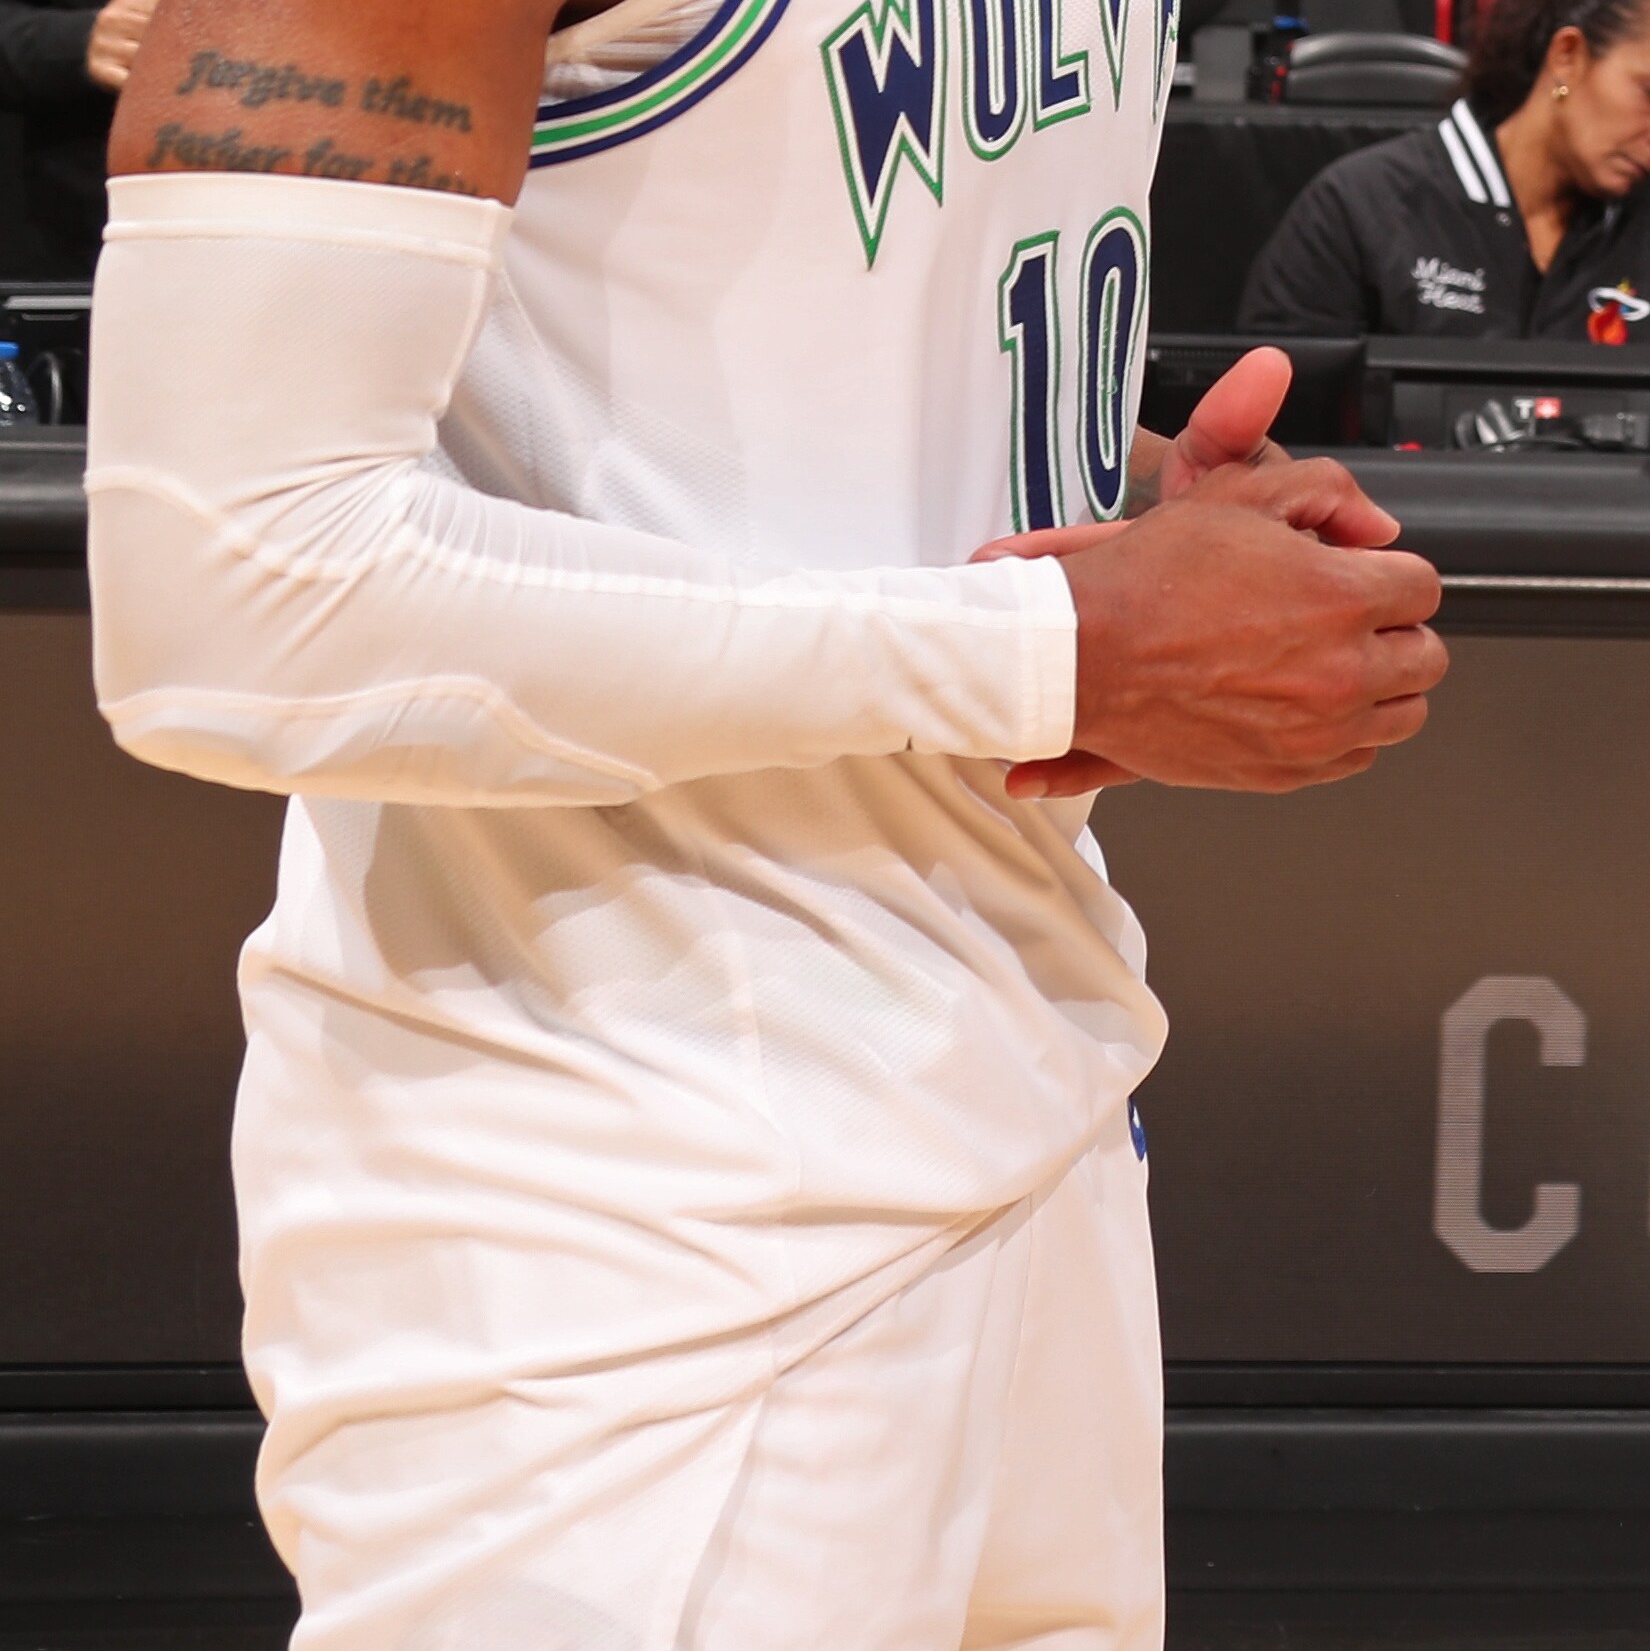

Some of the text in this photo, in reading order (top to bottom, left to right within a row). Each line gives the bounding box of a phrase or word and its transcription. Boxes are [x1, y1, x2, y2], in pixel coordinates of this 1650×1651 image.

[361, 72, 474, 134] them
[1410, 256, 1487, 292] Miami
[1416, 279, 1487, 315] Heat
[998, 205, 1148, 536] 10
